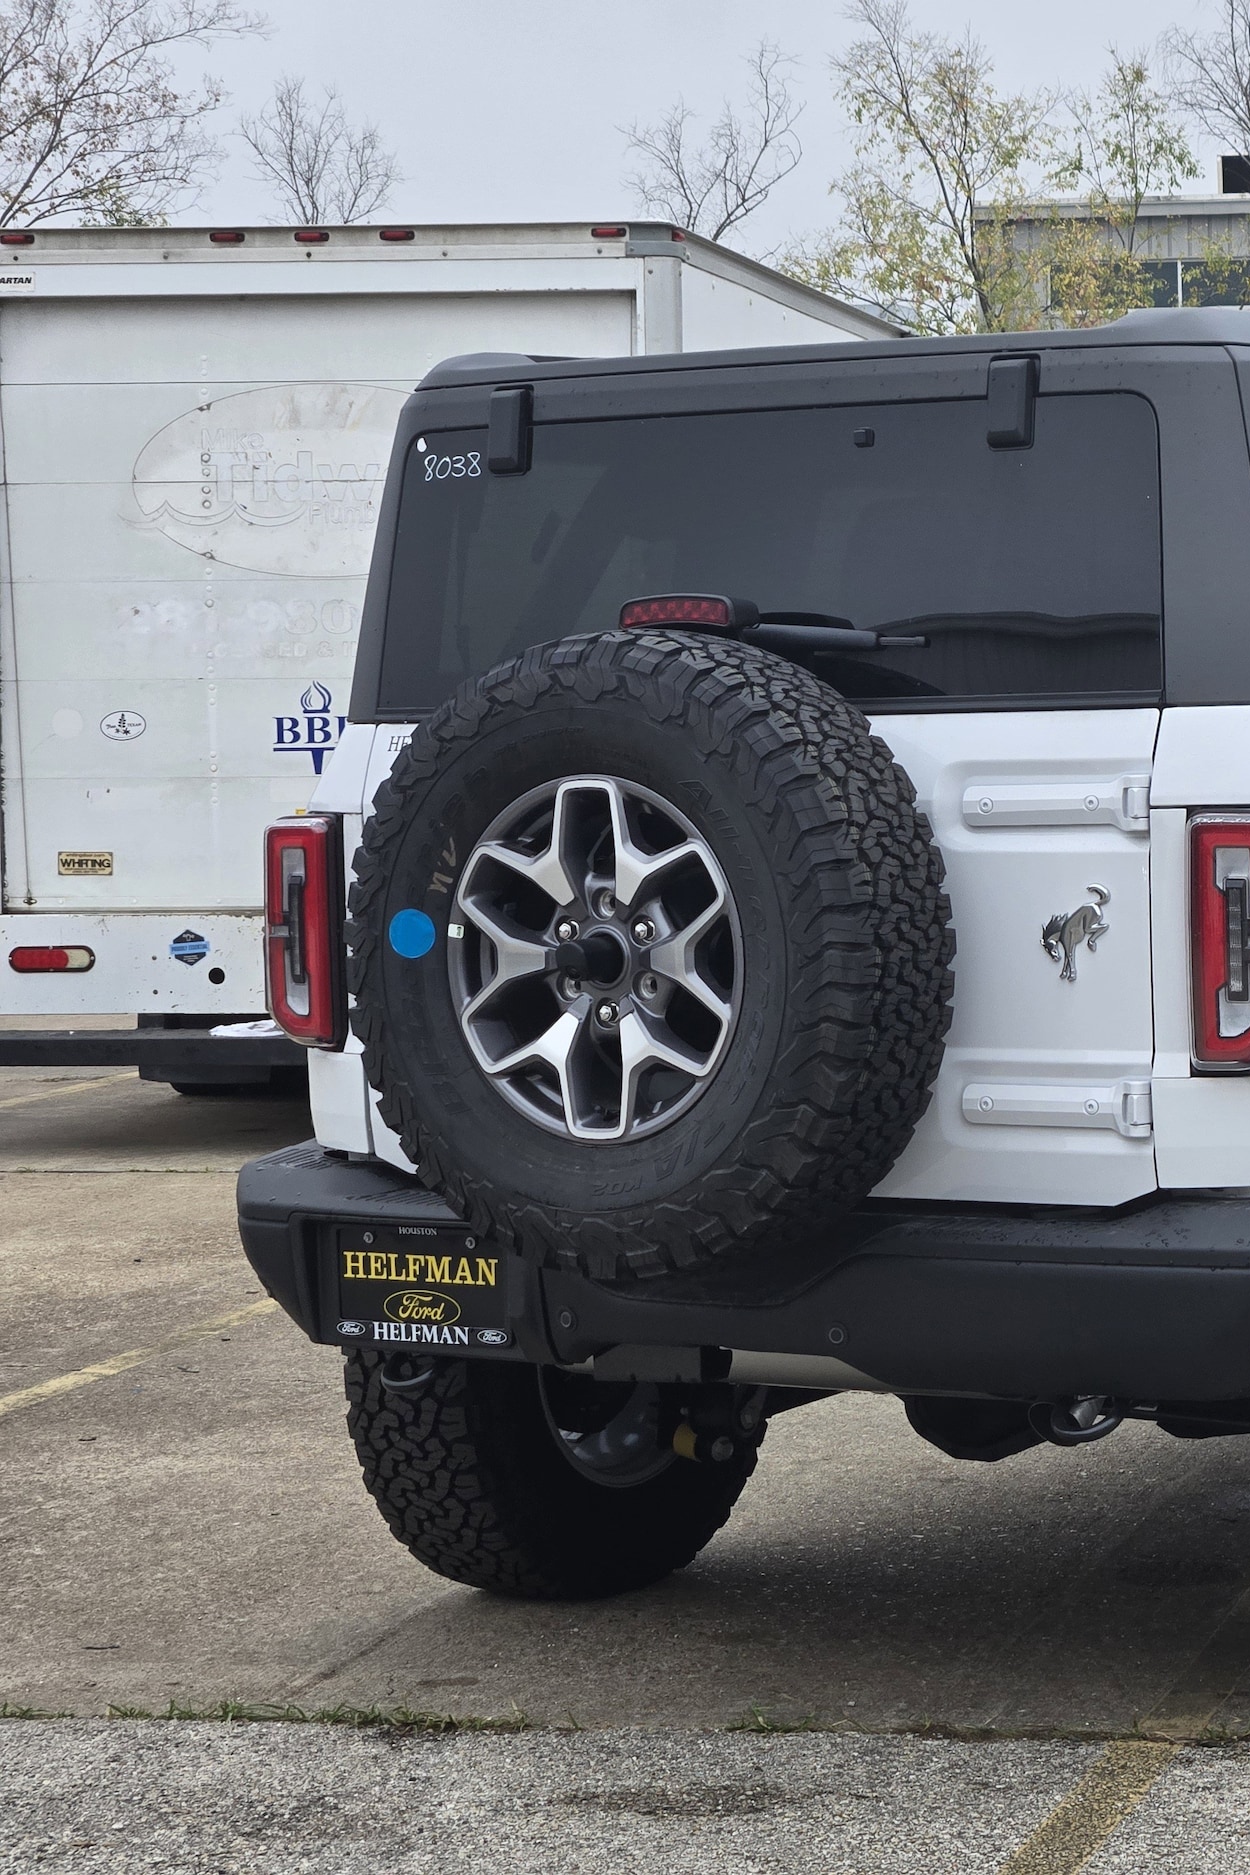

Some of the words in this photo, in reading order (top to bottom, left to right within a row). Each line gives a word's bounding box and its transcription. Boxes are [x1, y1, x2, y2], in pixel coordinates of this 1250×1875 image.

[201, 428, 264, 449] Mike
[201, 451, 387, 502] Tidw
[424, 452, 481, 482] 8038
[399, 1226, 438, 1236] HOUSTON
[343, 1251, 498, 1285] HELFMAN
[399, 1294, 445, 1320] Ford
[373, 1321, 469, 1345] HELFMAN
